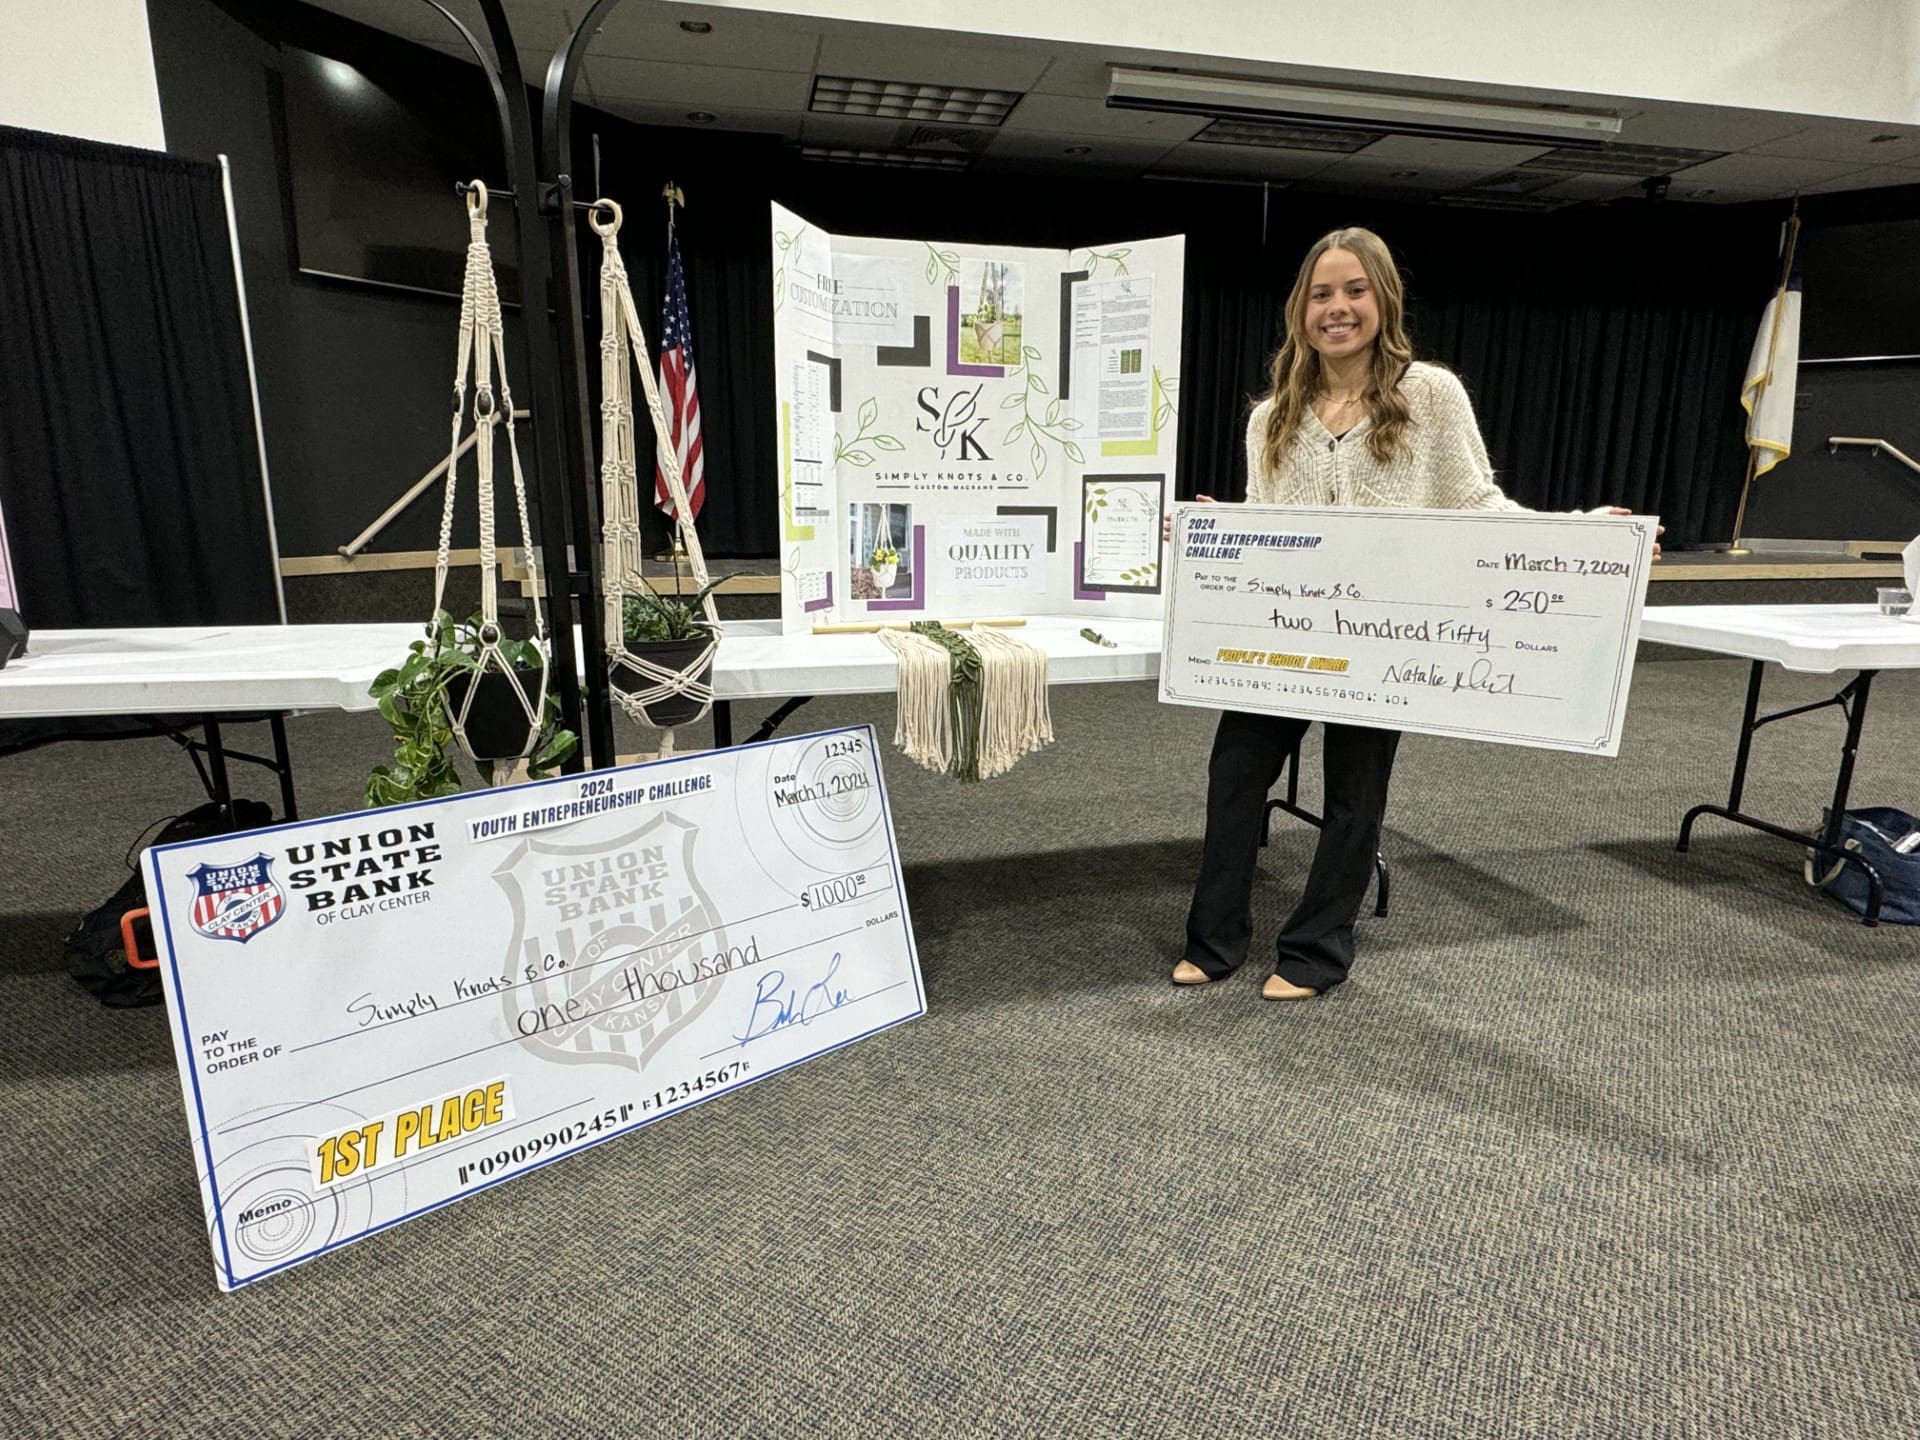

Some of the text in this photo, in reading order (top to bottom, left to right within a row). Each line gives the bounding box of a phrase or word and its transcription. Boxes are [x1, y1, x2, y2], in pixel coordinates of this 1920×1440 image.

[875, 472, 928, 481] SIMPLY
[937, 472, 982, 481] KNOTS
[991, 473, 998, 481] &
[963, 528, 1020, 538] MADE WITH
[1188, 518, 1216, 530] 2024
[1187, 532, 1322, 549] YOUTH ENTREPRENEURSHIP
[949, 543, 1034, 563] QUALITY
[1185, 546, 1243, 560] CHALLENGE
[1504, 552, 1567, 572] March
[954, 566, 1028, 580] PRODUCTS
[1248, 578, 1291, 600] Simply
[1486, 598, 1493, 608] $
[1268, 608, 1490, 654] two hundred Fifty
[1216, 648, 1350, 672] PEOPLE'S CHOICE AWARD
[1382, 658, 1447, 686] Natalie
[825, 739, 863, 758] 12345
[580, 777, 614, 799] 2024
[774, 773, 796, 784] Date
[472, 774, 712, 839] YOUTH ENTREPRENEURSHIP CHALLENGE
[774, 784, 816, 808] March
[284, 822, 436, 865] UNION
[206, 864, 259, 880] UNION
[288, 844, 442, 889] STATE
[541, 844, 665, 887] UNION
[206, 870, 261, 887] STATE
[212, 878, 258, 892] BANK
[305, 868, 435, 912] BANK
[543, 862, 669, 906] STATE
[208, 891, 270, 930] CLAY CENTER
[317, 890, 431, 926] OF CLAY CENTER
[558, 881, 665, 923] BANK
[800, 892, 810, 908] $
[865, 911, 899, 927] DOLLARS
[586, 934, 609, 958] OF
[517, 935, 761, 1036] one thousand
[346, 992, 438, 1026] Simply
[553, 985, 606, 1038] CAY
[201, 1030, 229, 1046] PAY
[203, 1037, 257, 1060] TO THE
[206, 1045, 282, 1074] ORDER OF
[316, 1080, 505, 1185] 1ST PLACE
[238, 1198, 292, 1225] Memo
